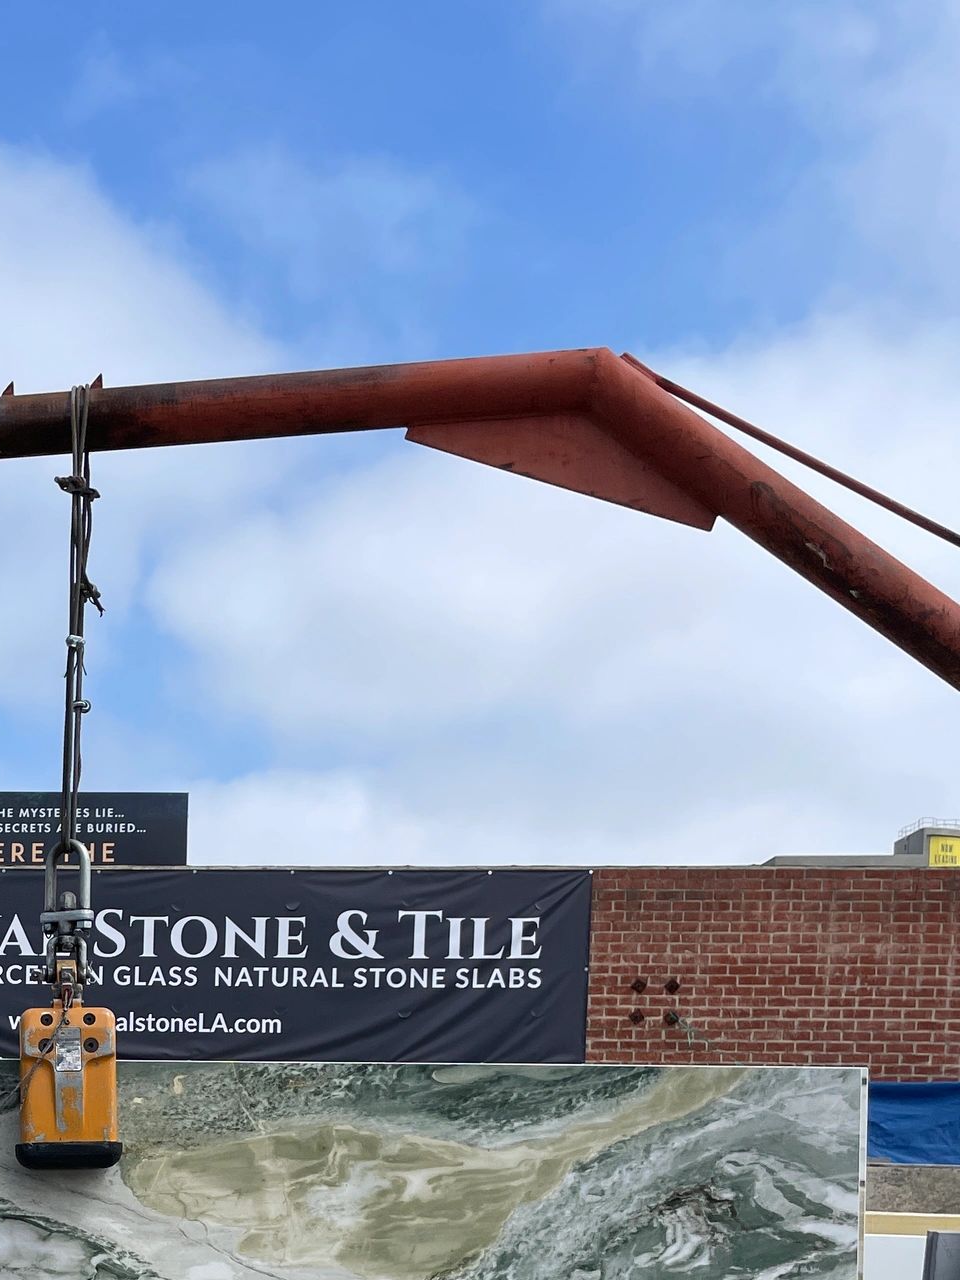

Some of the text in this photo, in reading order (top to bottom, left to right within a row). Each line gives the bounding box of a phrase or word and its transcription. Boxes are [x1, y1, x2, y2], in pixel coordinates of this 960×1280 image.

[19, 807, 90, 819] MYSTEES
[56, 823, 82, 834] AE
[93, 908, 309, 959] STONE
[328, 909, 385, 960] &
[398, 909, 542, 960] TILE
[113, 965, 199, 987] GLASS
[214, 966, 345, 988] NATURAL
[353, 967, 446, 989] STONE
[455, 967, 542, 989] SLABS
[8, 1011, 282, 1034] walstoneLA.com
